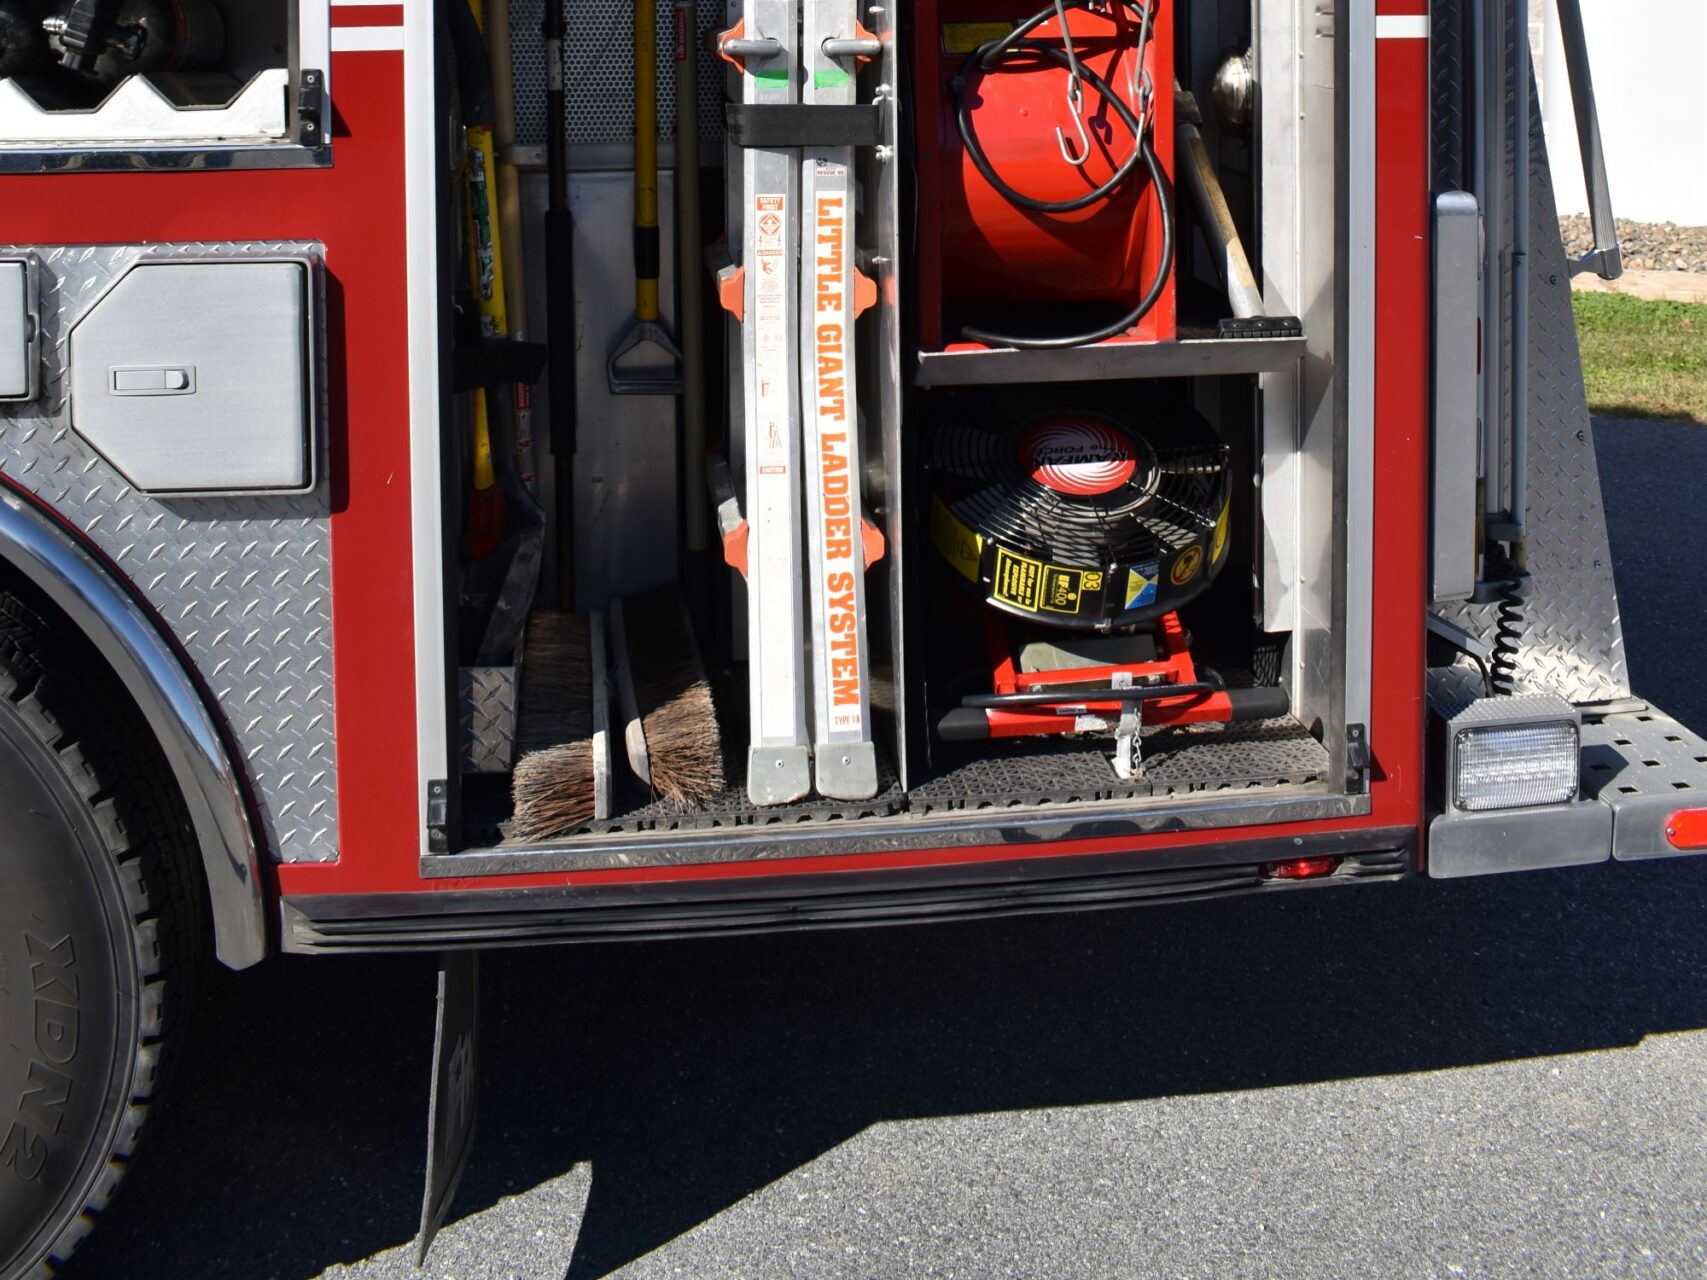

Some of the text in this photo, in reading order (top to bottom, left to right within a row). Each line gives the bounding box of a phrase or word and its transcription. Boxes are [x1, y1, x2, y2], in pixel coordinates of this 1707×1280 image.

[816, 197, 861, 706] LITTLE GIANT LADDER SYSTEM
[1037, 445, 1084, 454] FORCE
[1033, 451, 1128, 468] RAMFAN
[1027, 564, 1035, 578] NOT
[1056, 574, 1070, 606] EF400
[1084, 573, 1101, 590] 03
[834, 716, 850, 725] TYPE
[0, 931, 81, 1184] XDN2
